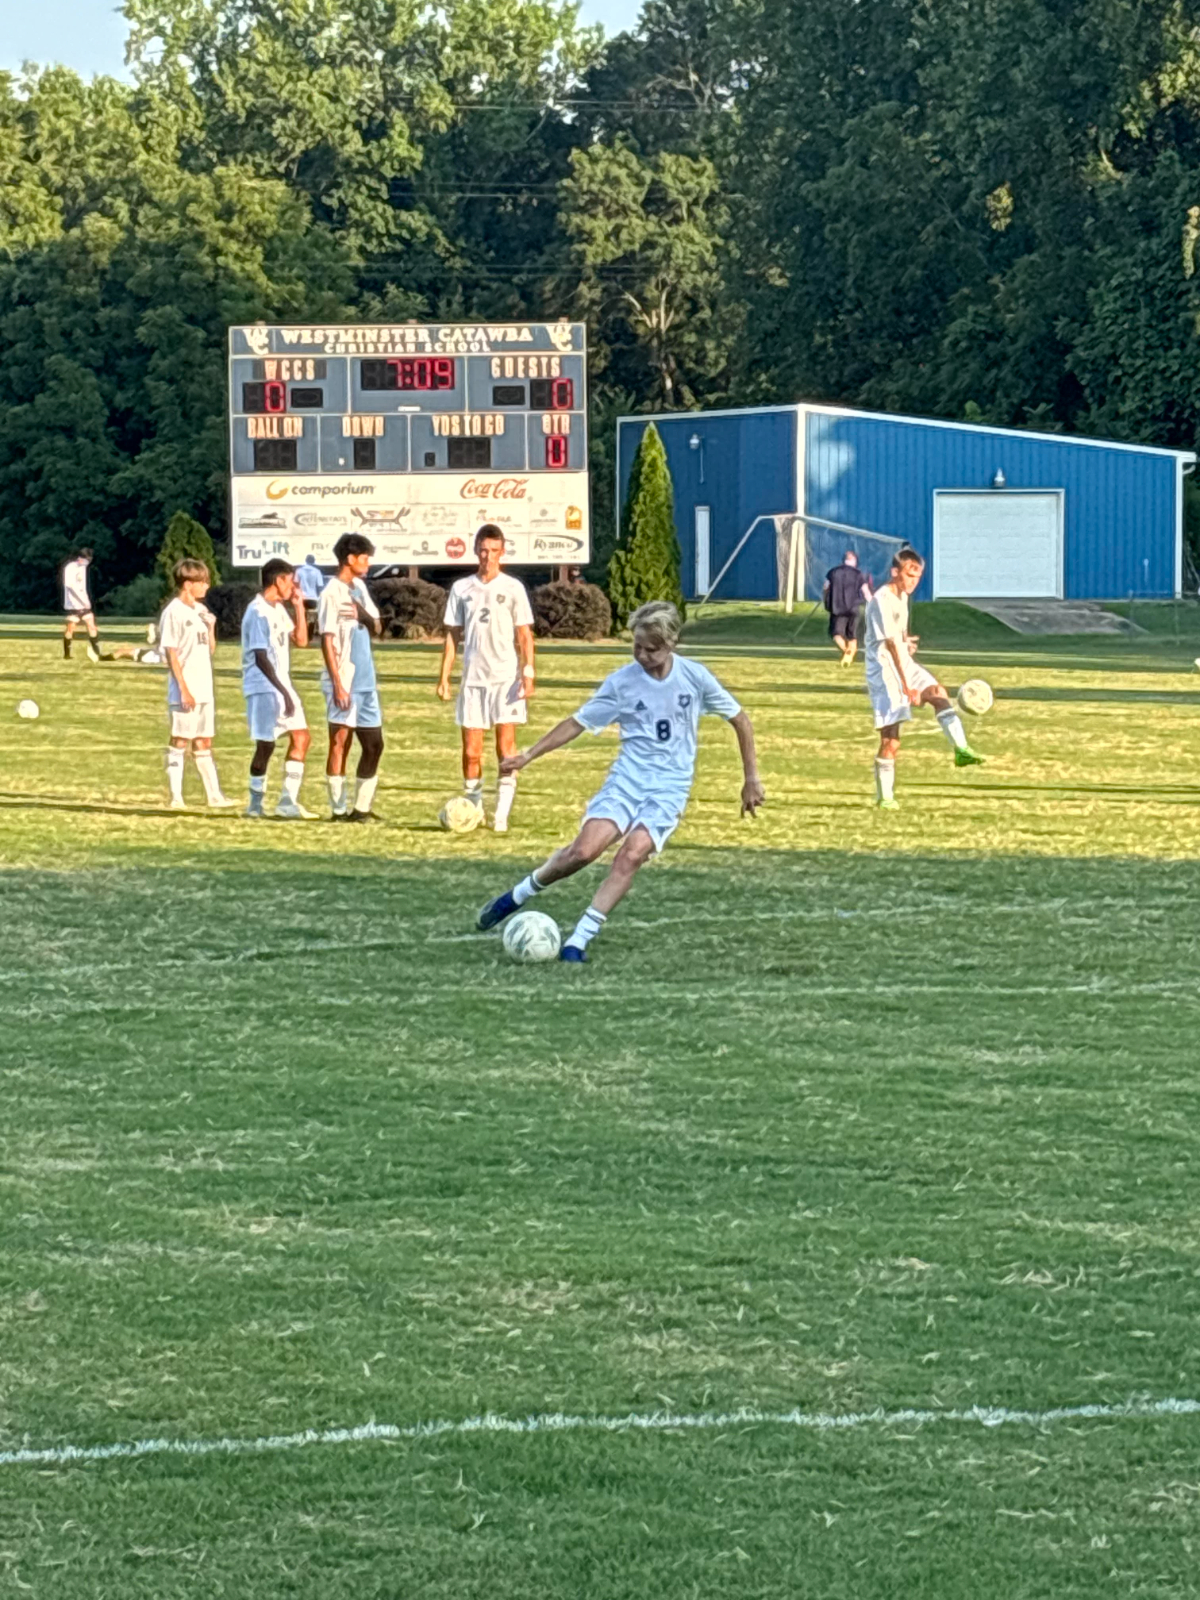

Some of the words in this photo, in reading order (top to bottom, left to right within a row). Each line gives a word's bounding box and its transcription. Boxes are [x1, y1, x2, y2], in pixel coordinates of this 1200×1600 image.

[280, 328, 430, 344] WESTMINSTER
[438, 327, 534, 342] CATAWBA
[324, 343, 416, 353] CHRISTIAN
[424, 342, 491, 352] SCHOOL
[264, 359, 315, 381] WCCS
[386, 359, 452, 390] 7:09
[491, 356, 561, 378] GUESTS
[265, 382, 285, 412] 0
[552, 378, 572, 410] 0
[247, 417, 279, 438] BALL
[283, 417, 303, 437] ON
[342, 416, 384, 437] DOWN
[547, 436, 567, 467] 0
[291, 482, 375, 499] comporium
[478, 608, 490, 624] 2
[656, 718, 671, 741] 8
